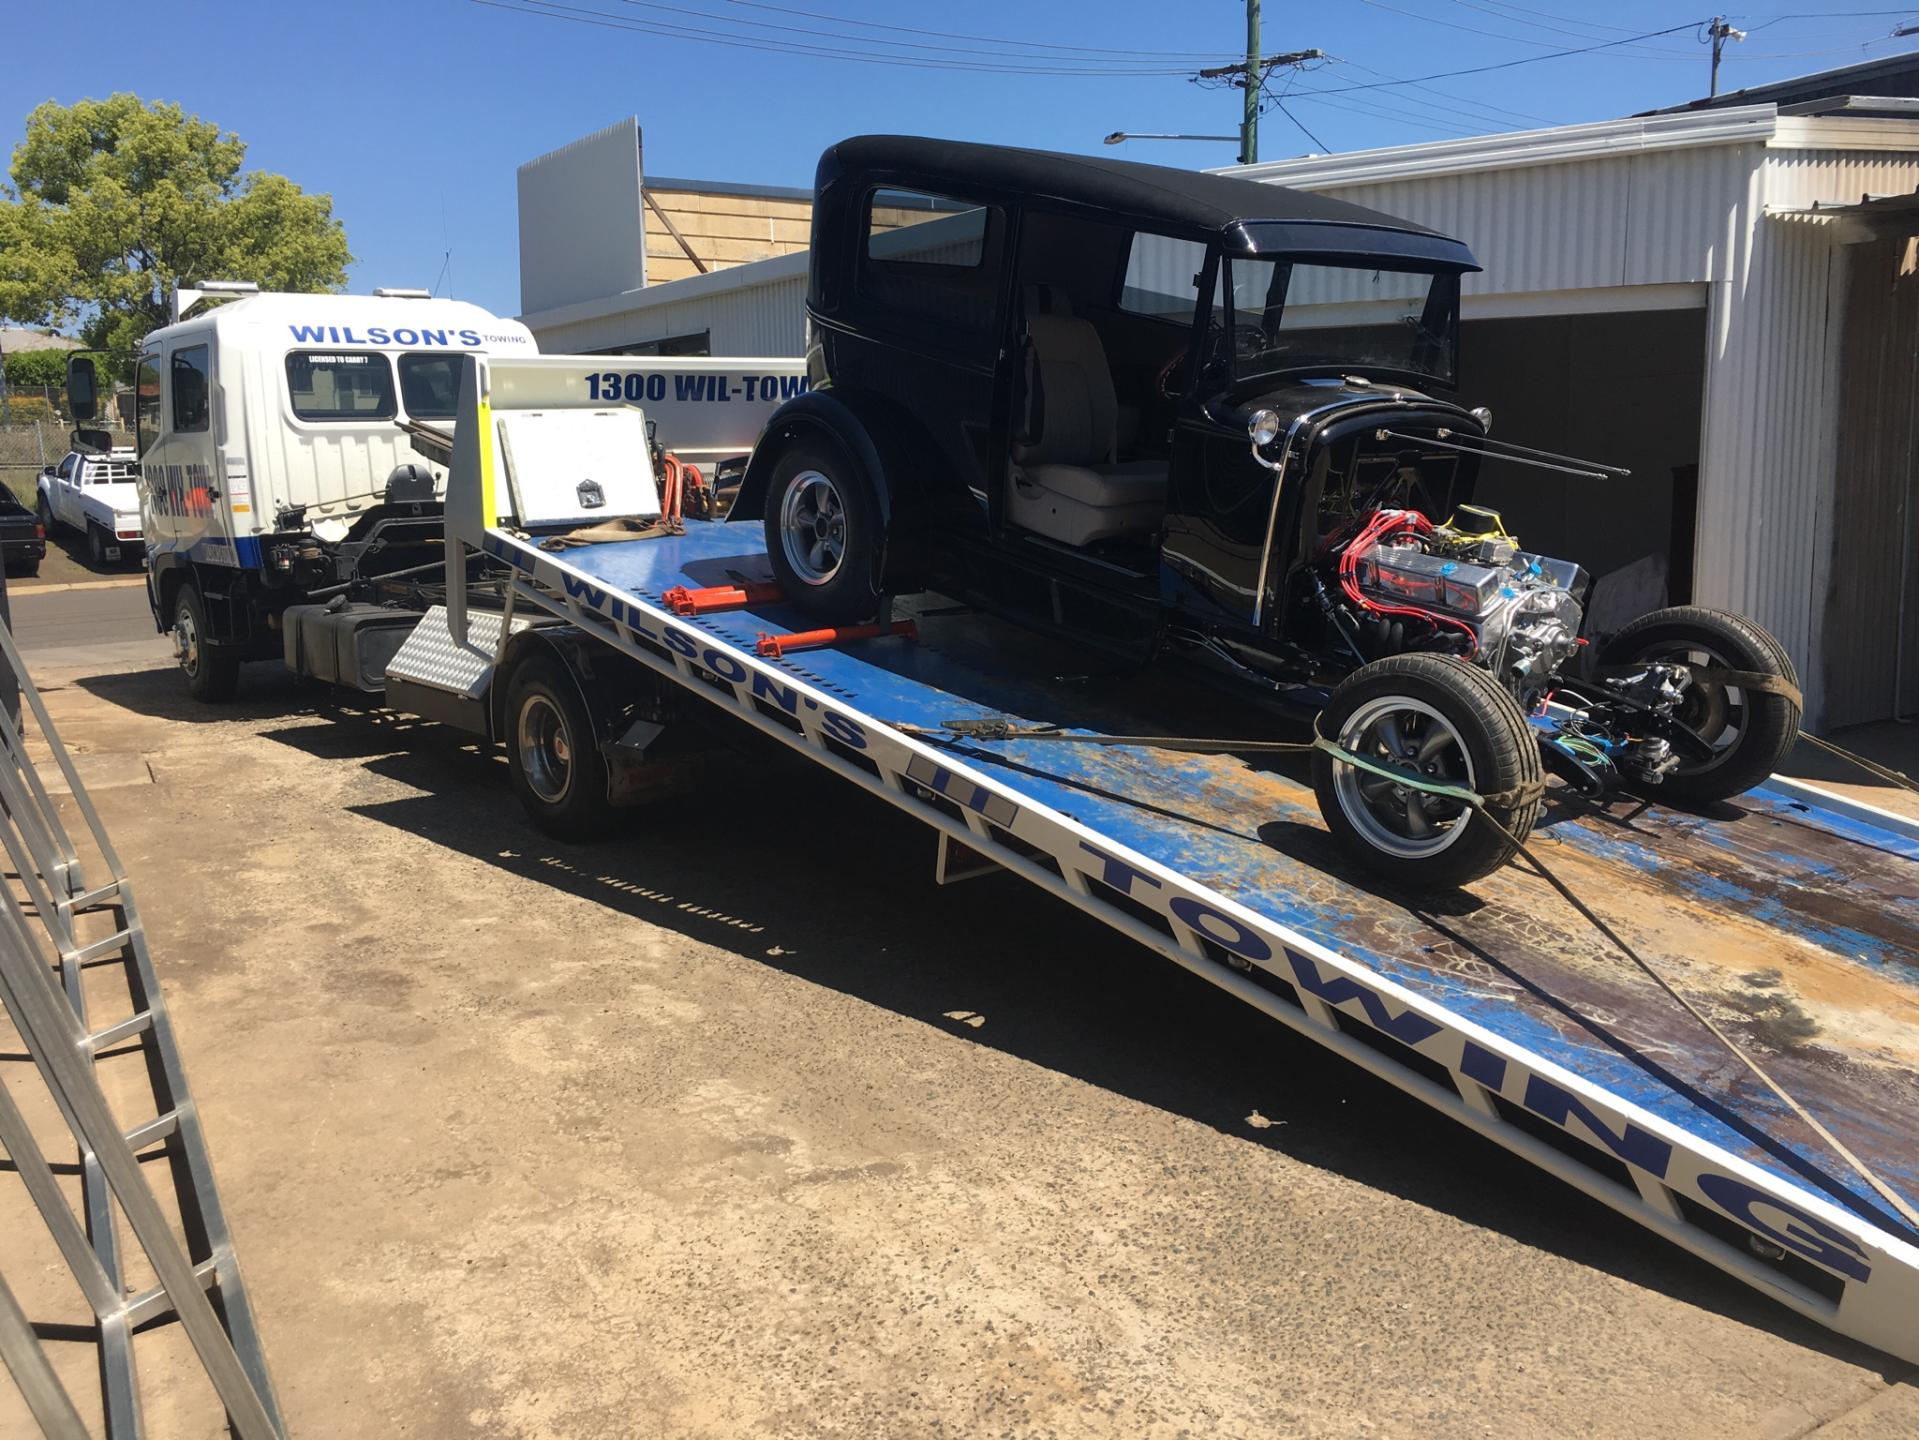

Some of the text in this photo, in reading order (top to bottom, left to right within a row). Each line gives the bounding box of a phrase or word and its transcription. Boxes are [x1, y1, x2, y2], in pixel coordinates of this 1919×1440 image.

[289, 325, 527, 346] WILSON'S TOWING
[585, 373, 811, 401] 1300 WIL-TOW
[561, 572, 867, 749] WILSON'S
[1079, 840, 1872, 1284] TOWING
